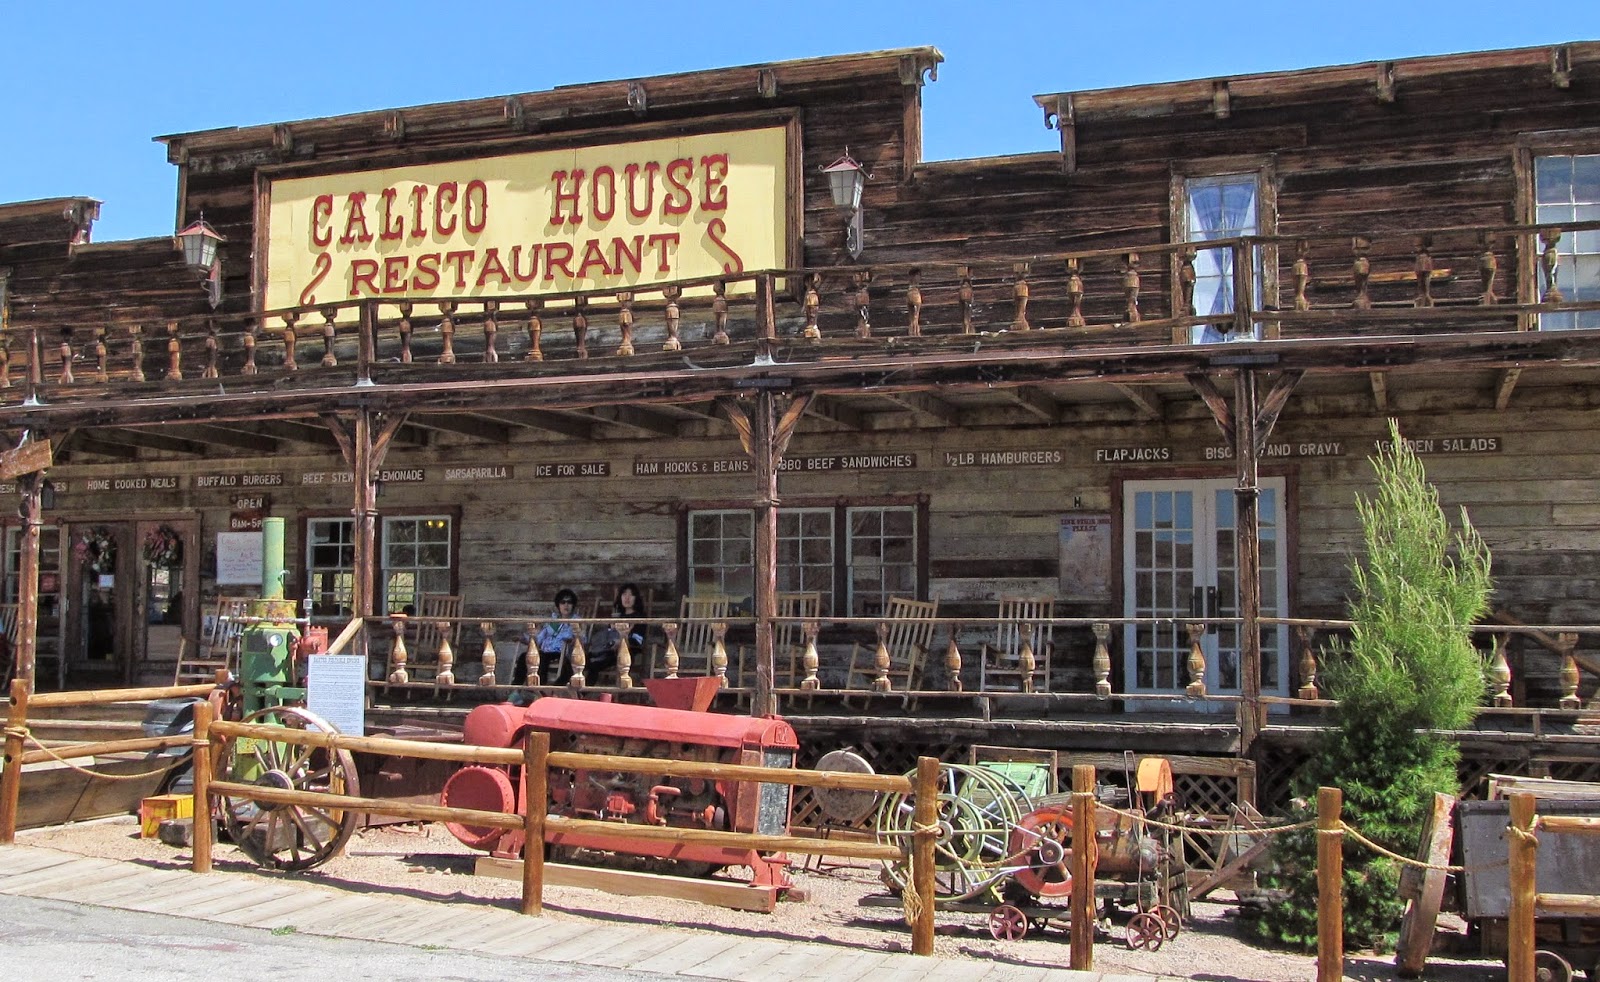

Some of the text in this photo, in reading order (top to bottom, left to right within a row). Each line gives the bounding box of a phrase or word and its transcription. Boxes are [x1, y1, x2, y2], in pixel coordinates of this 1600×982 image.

[313, 153, 730, 247] CALICO HOUSE
[350, 233, 681, 296] RESTAURANT
[1205, 442, 1340, 459] BISC AND GRAVY
[1381, 439, 1497, 452] GDEN SALADS
[981, 451, 1061, 464] HAMBURGERS
[1096, 448, 1169, 461] FLAPJACKS
[636, 462, 658, 474] HAM
[664, 461, 698, 473] HOCKS
[713, 460, 749, 472] BEANS
[807, 457, 836, 470] BEEF
[841, 455, 912, 468] SANDWICHES
[445, 467, 507, 480] SARSAPARILLA
[536, 463, 605, 476] ICE FOR SALE
[87, 478, 176, 490] HOME COOKED MEALS
[197, 474, 282, 487] BUFFALO BURGERS
[302, 472, 355, 484] BEEF STEW
[237, 498, 263, 509] OPEN
[231, 517, 264, 529] 8AM-5P
